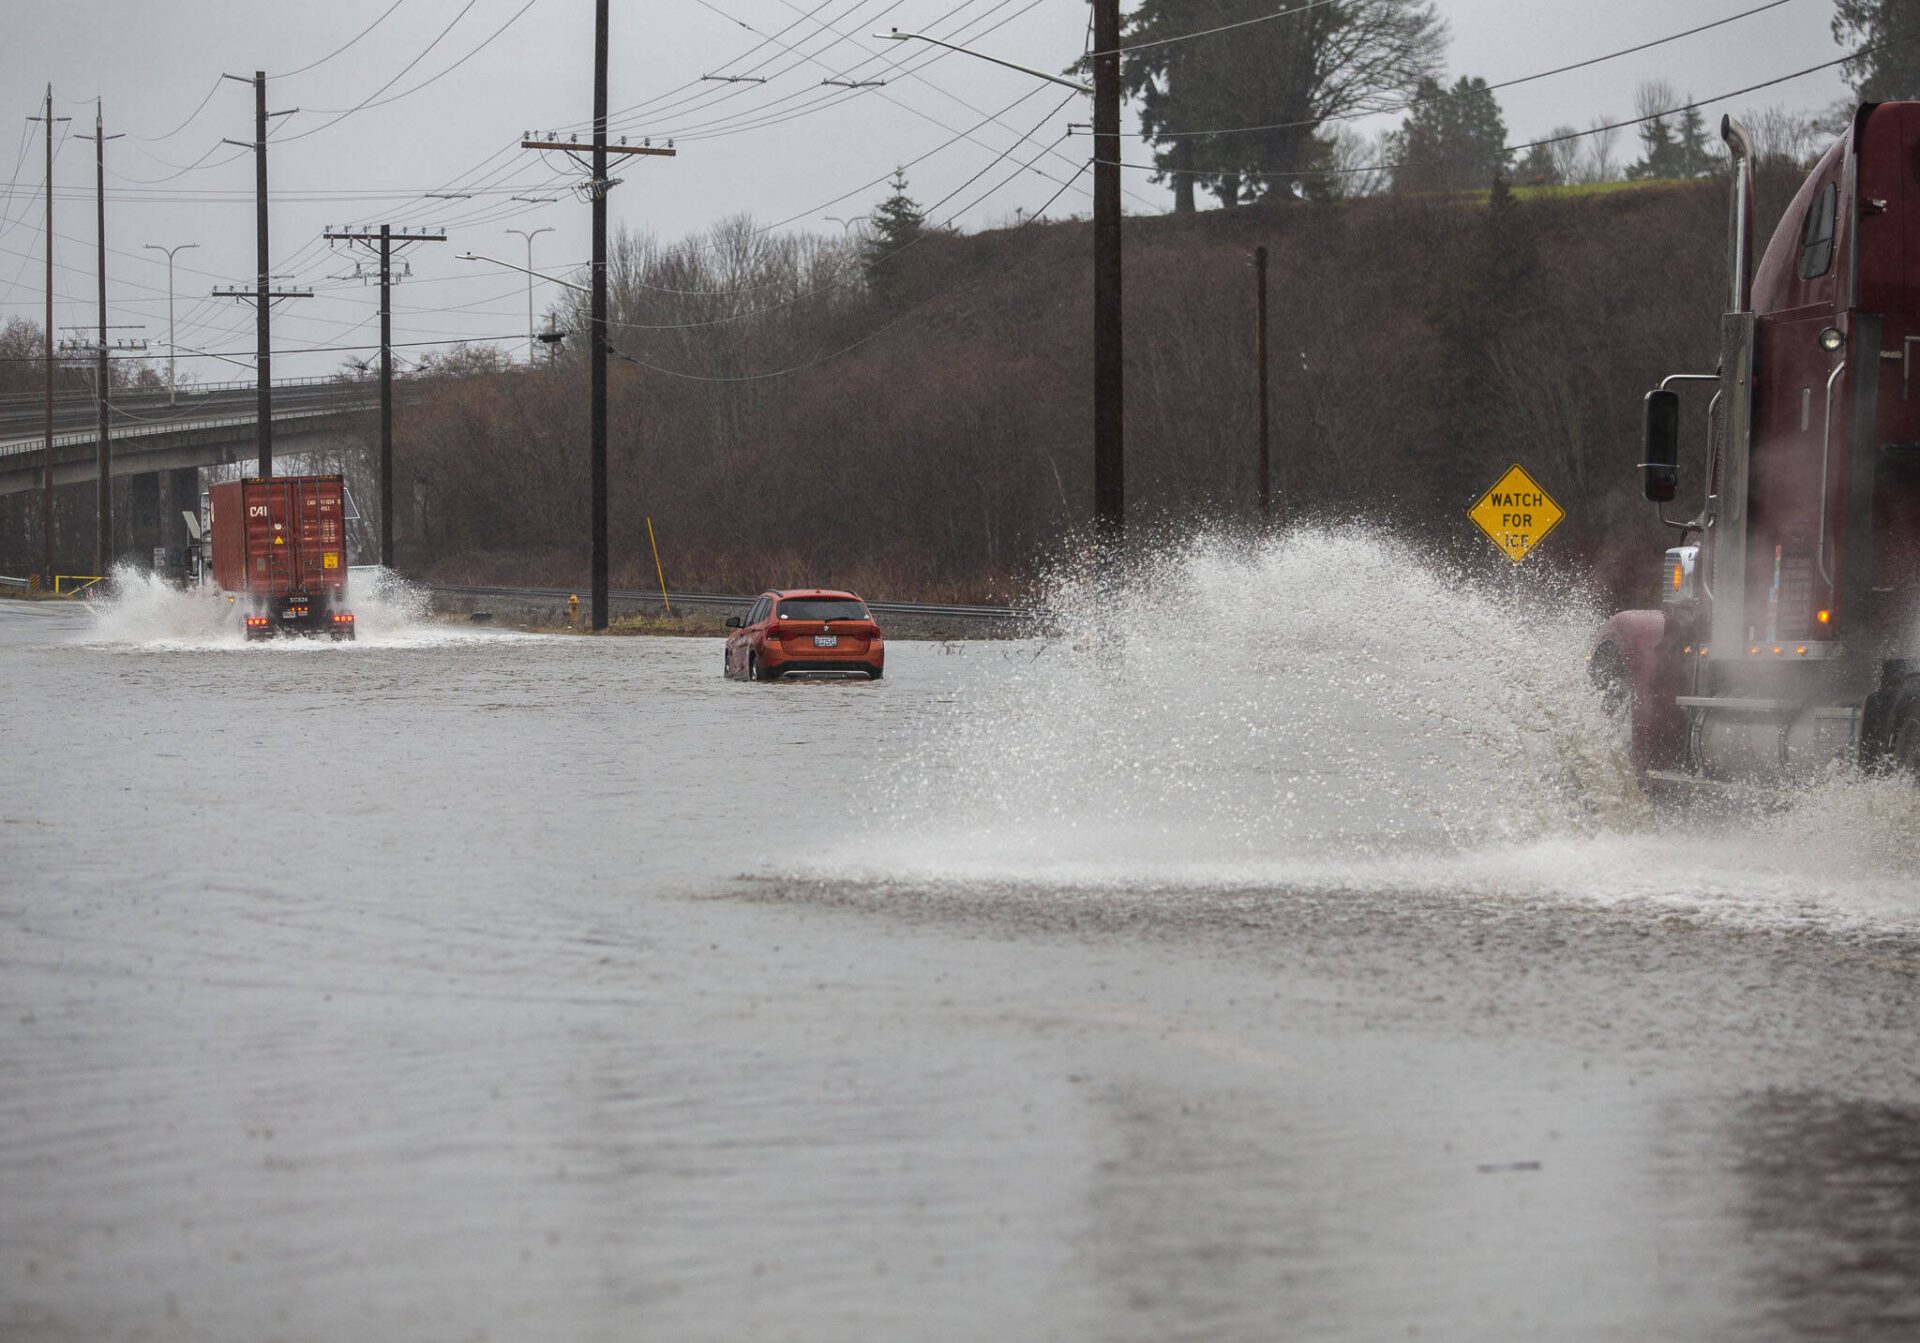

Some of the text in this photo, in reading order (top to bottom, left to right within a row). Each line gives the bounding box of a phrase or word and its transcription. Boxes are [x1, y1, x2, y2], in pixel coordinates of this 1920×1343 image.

[1491, 493, 1542, 507] WATCH
[249, 505, 267, 517] CAI
[1503, 514, 1532, 527] FOR
[1505, 534, 1529, 547] ICE
